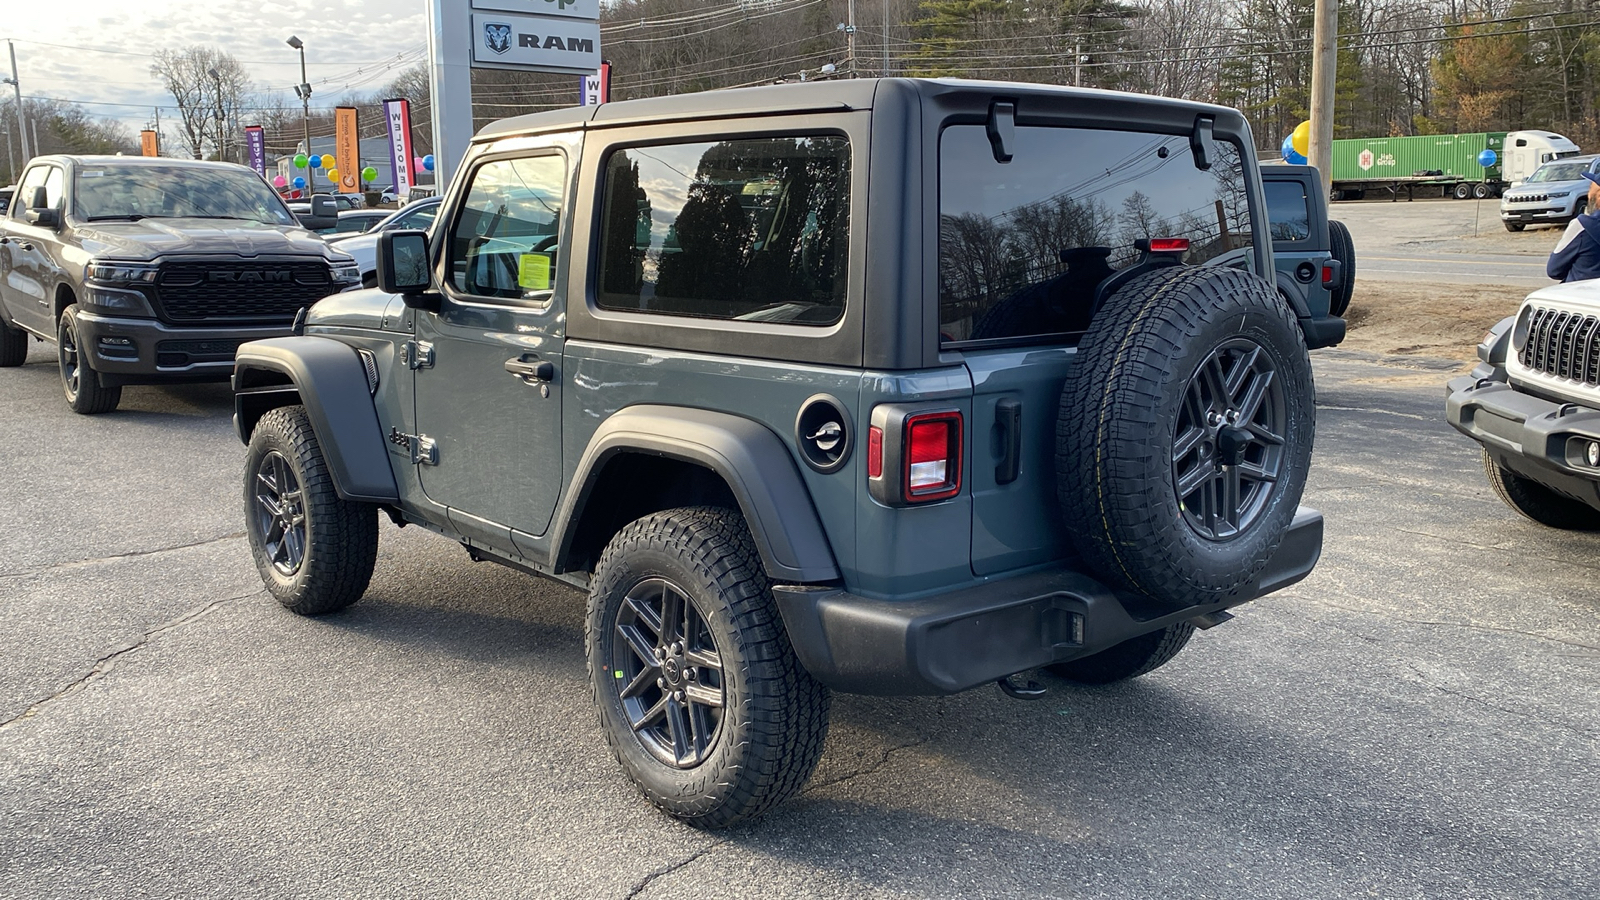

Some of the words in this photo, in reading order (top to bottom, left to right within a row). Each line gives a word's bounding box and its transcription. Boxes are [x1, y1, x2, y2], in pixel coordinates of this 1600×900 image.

[518, 33, 594, 53] RAM
[1377, 158, 1396, 167] Group
[208, 270, 290, 281] RAM
[593, 559, 631, 650] NEXEN
[711, 671, 738, 784] ROADIAN
[674, 775, 706, 799] ATX
